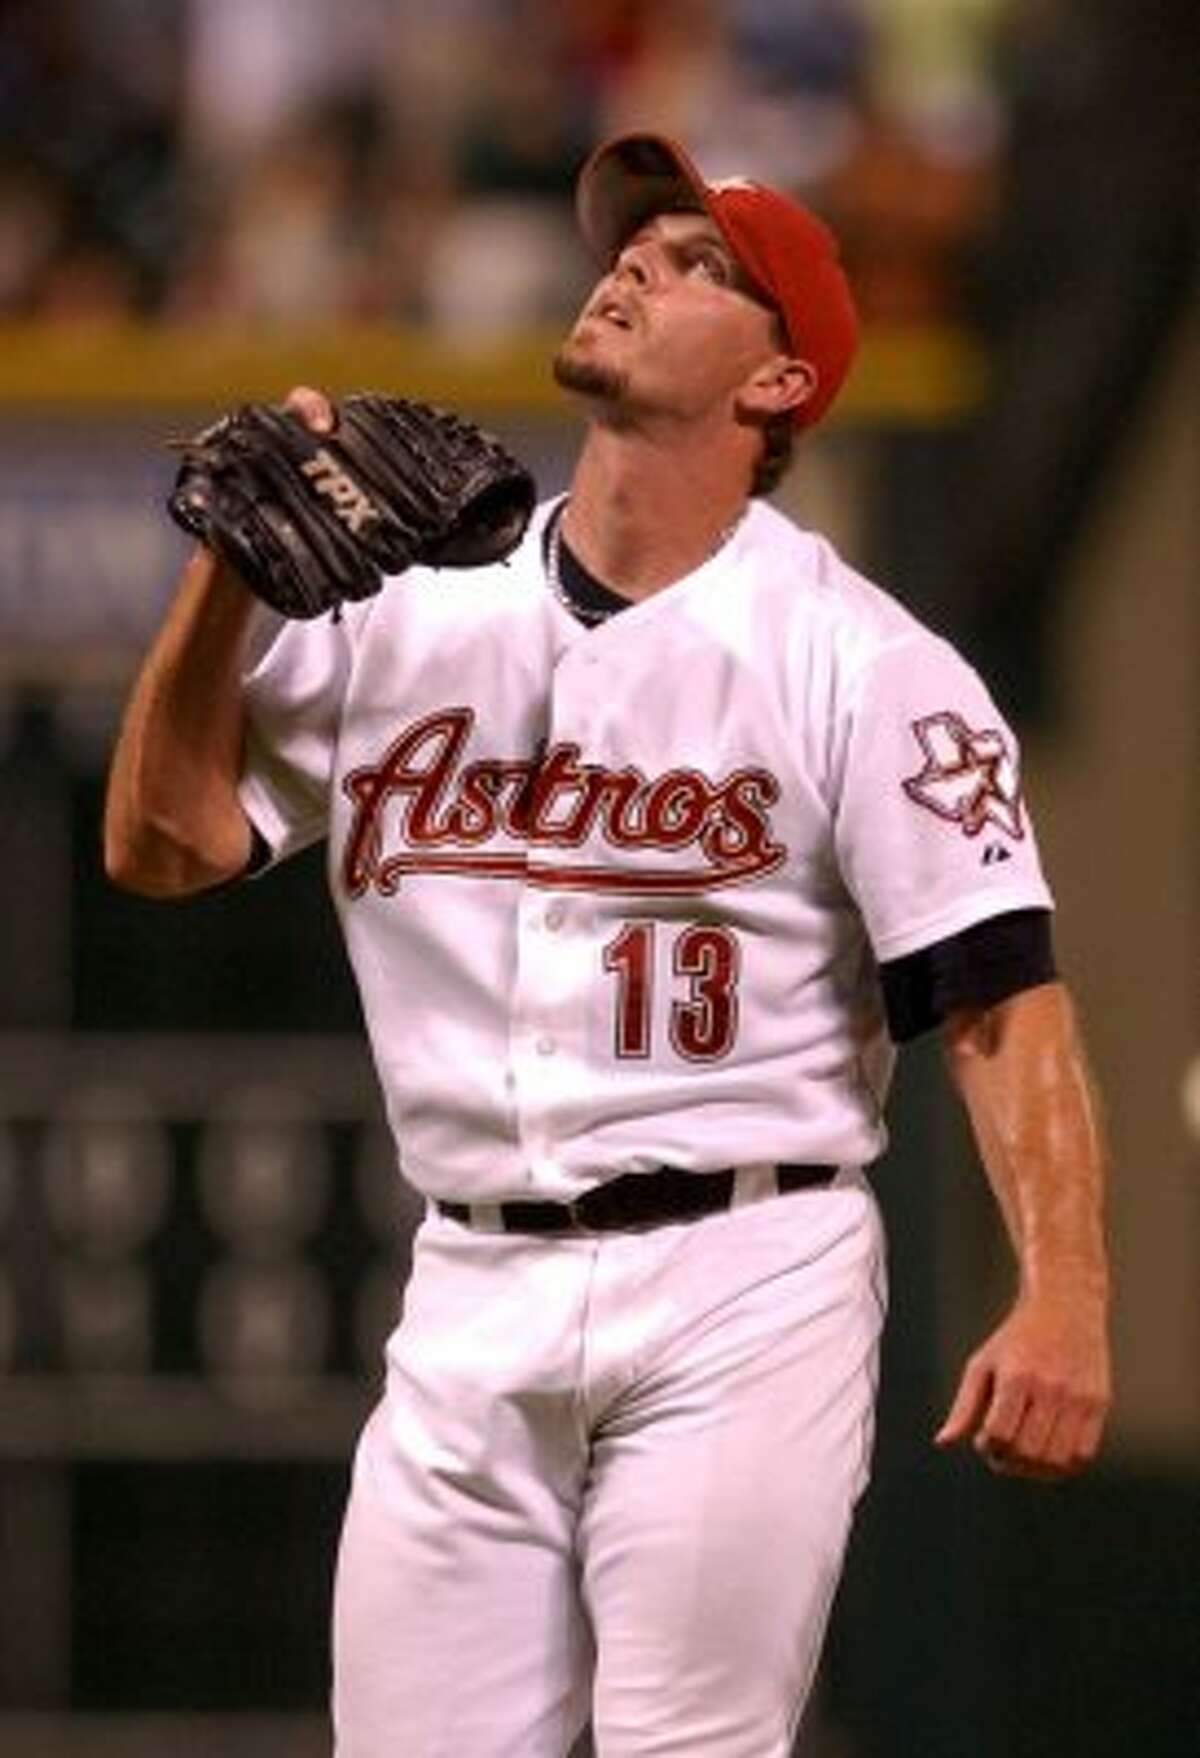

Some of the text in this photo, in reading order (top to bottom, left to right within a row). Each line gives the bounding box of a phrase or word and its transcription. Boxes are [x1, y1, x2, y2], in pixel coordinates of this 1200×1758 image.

[301, 448, 379, 533] TPX
[343, 707, 787, 897] Astros
[602, 922, 742, 1063] 13
